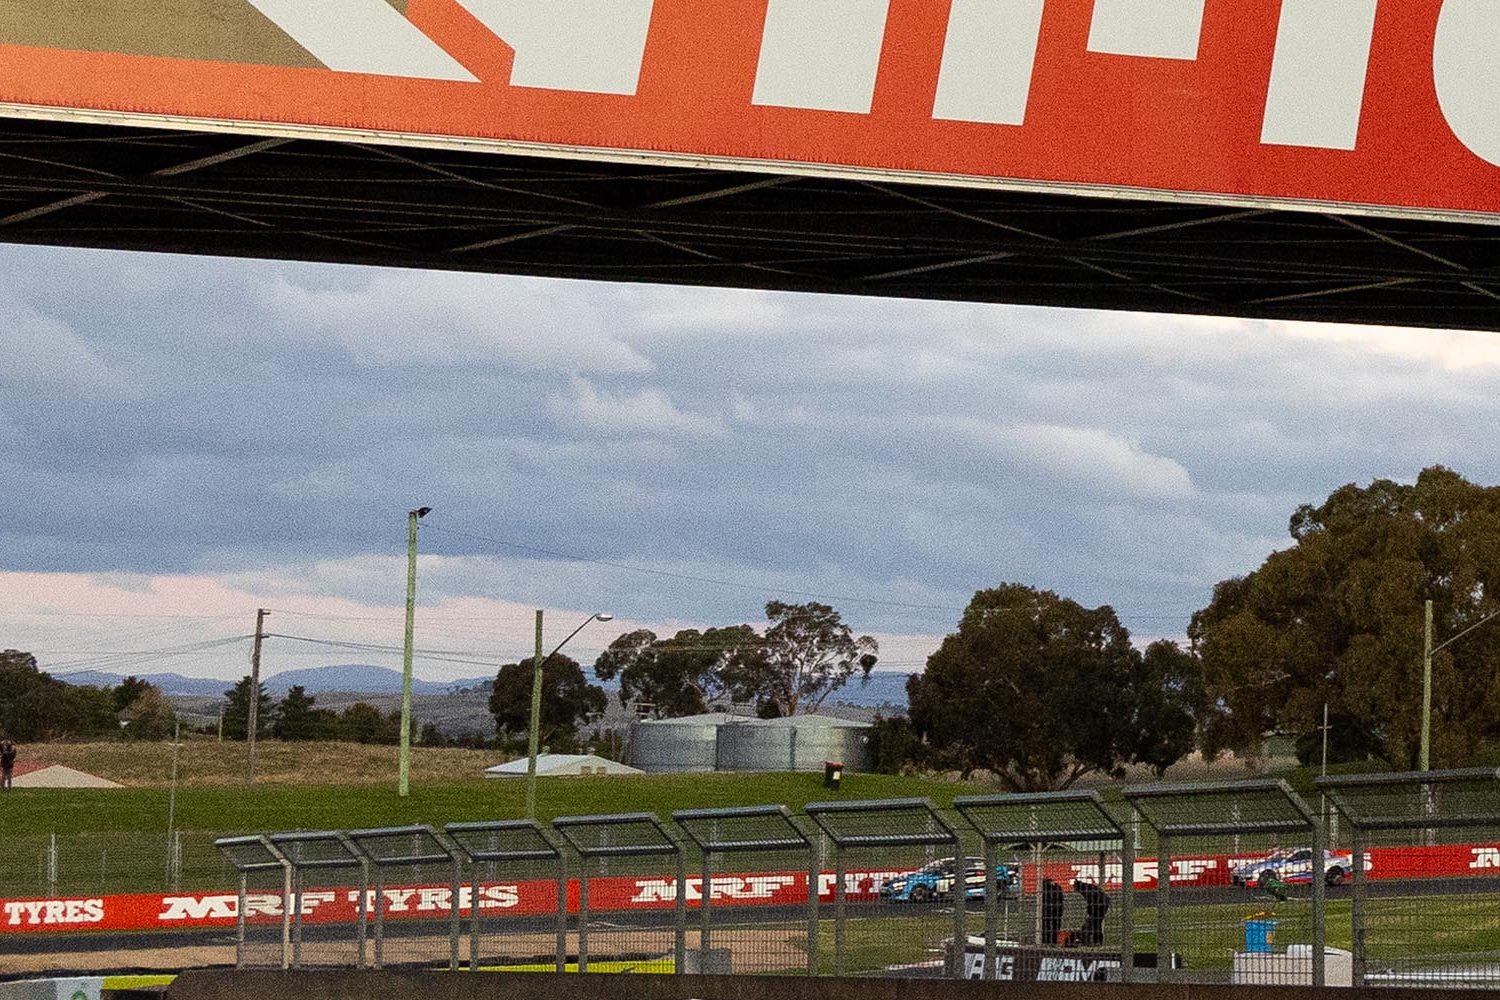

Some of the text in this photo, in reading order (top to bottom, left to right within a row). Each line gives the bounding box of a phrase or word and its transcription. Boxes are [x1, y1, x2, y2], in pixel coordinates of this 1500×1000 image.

[160, 885, 520, 922] MRF TYRES
[631, 876, 795, 904] MRF
[4, 898, 105, 926] TYRES
